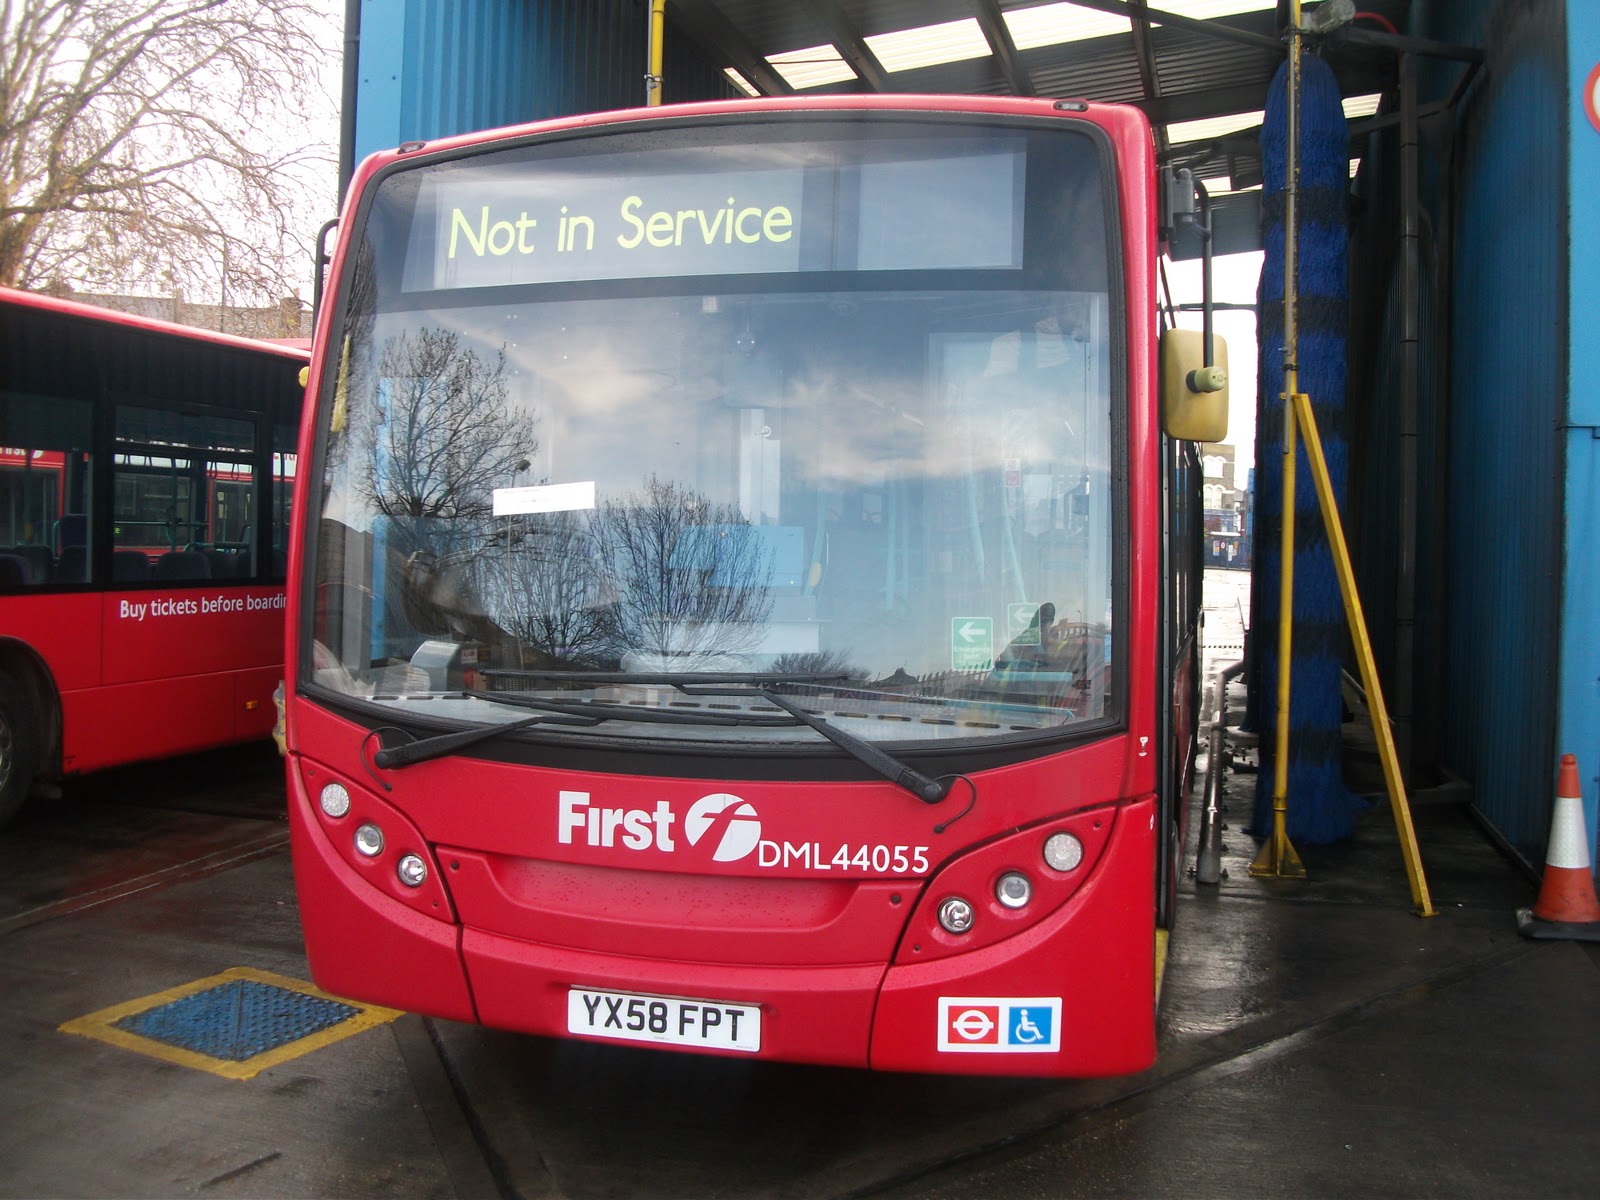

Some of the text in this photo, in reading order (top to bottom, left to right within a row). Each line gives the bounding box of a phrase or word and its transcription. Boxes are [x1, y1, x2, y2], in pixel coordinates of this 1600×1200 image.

[448, 195, 793, 259] Not in Service
[120, 599, 147, 622] Buy
[151, 598, 198, 617] tickets
[201, 595, 244, 614] before
[953, 645, 991, 653] Emergency
[558, 790, 675, 853] First
[758, 840, 930, 874] DML44055
[582, 994, 745, 1042] YX58 FPT
